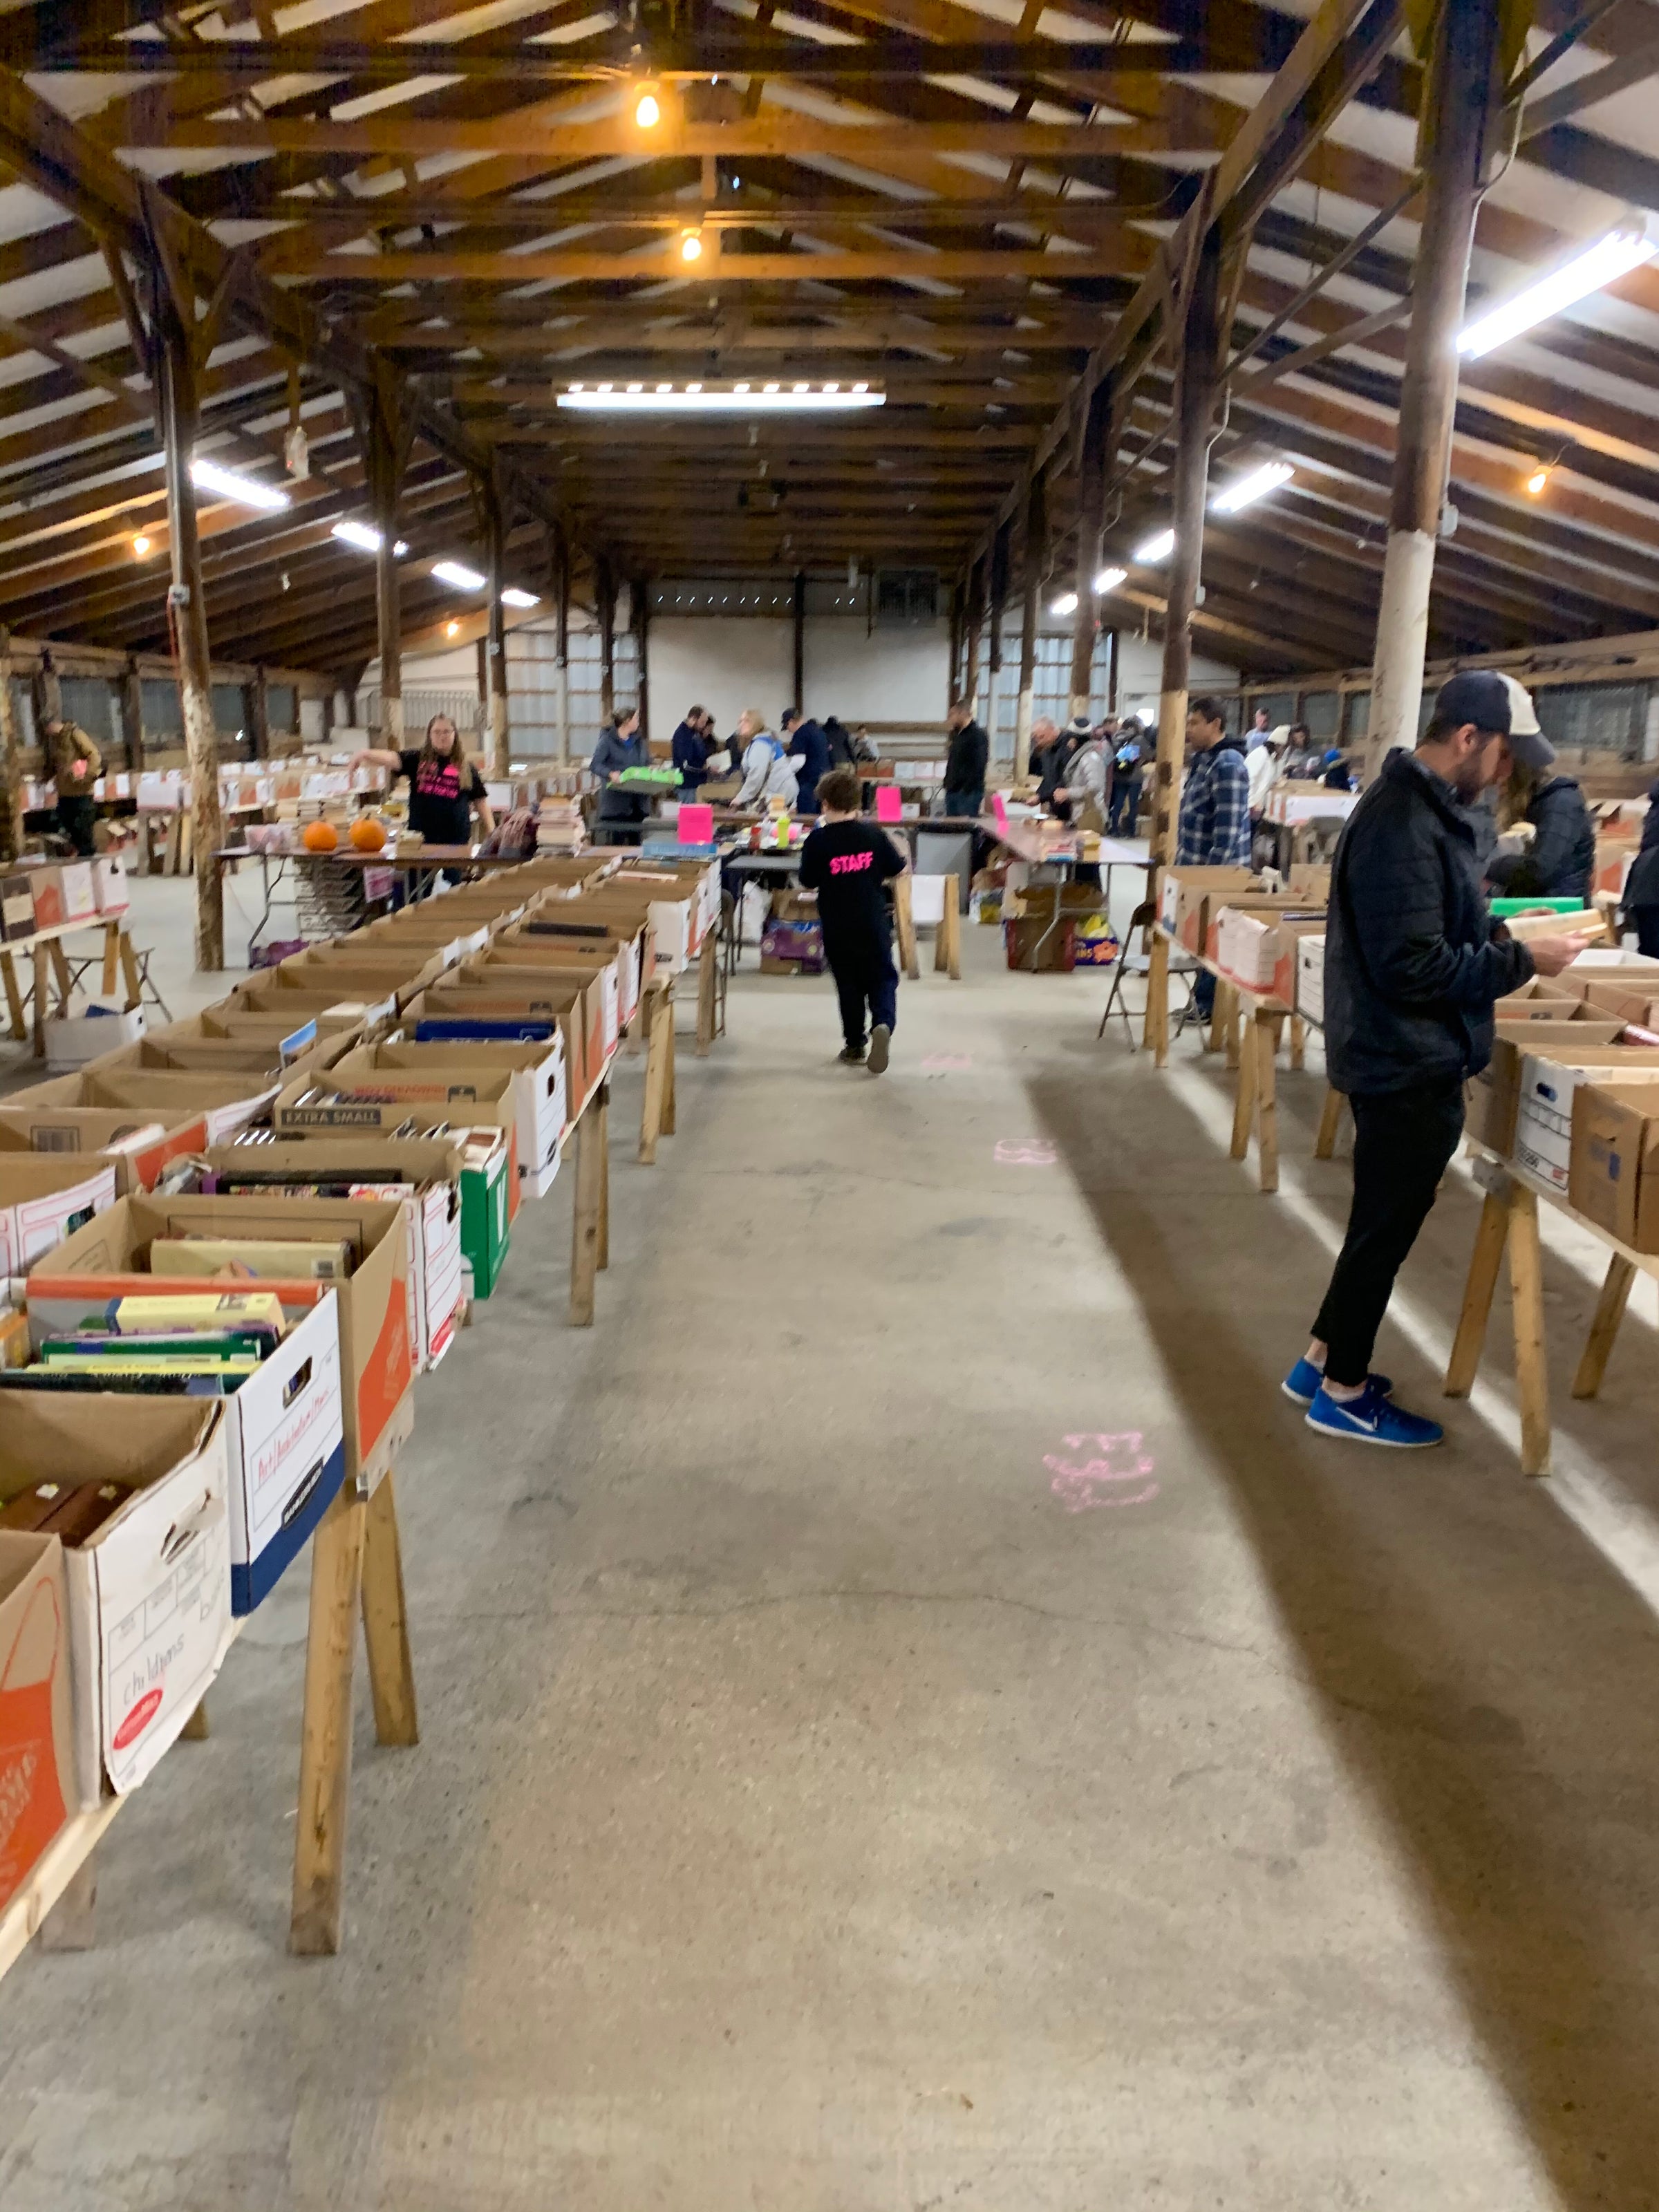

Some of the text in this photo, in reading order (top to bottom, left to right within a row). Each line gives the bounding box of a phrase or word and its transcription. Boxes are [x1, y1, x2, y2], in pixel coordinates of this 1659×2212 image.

[830, 851, 873, 875] STAFF
[285, 1110, 377, 1123] EXTRA SMALL
